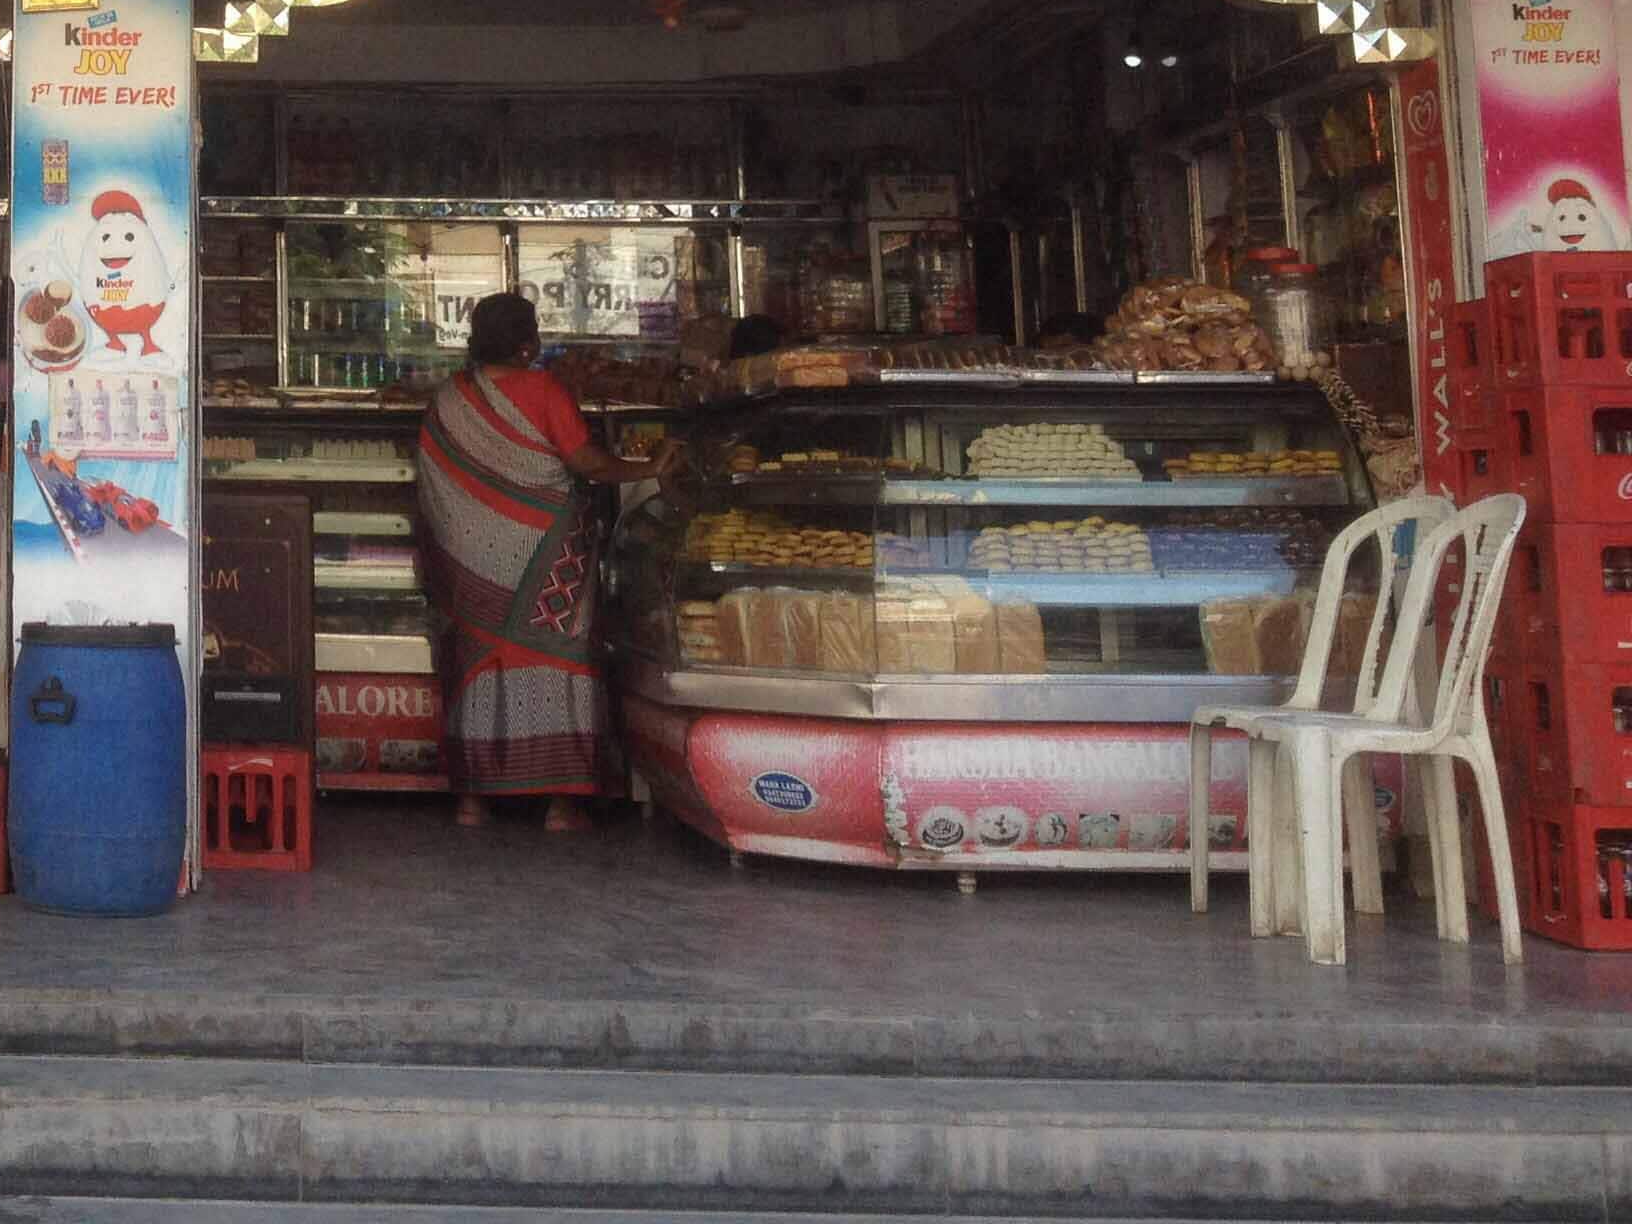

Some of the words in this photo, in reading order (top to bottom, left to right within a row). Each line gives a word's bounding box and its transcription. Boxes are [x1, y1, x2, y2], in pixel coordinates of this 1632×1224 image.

[1512, 4, 1571, 21] Kinder
[65, 23, 142, 47] Kinder
[1522, 22, 1565, 42] JOY
[73, 49, 131, 76] JOY
[1512, 49, 1549, 65] TIME
[1555, 49, 1600, 66] EVER!
[58, 85, 109, 106] TIME
[115, 85, 176, 108] EVER!
[1428, 278, 1453, 456] WALL'S
